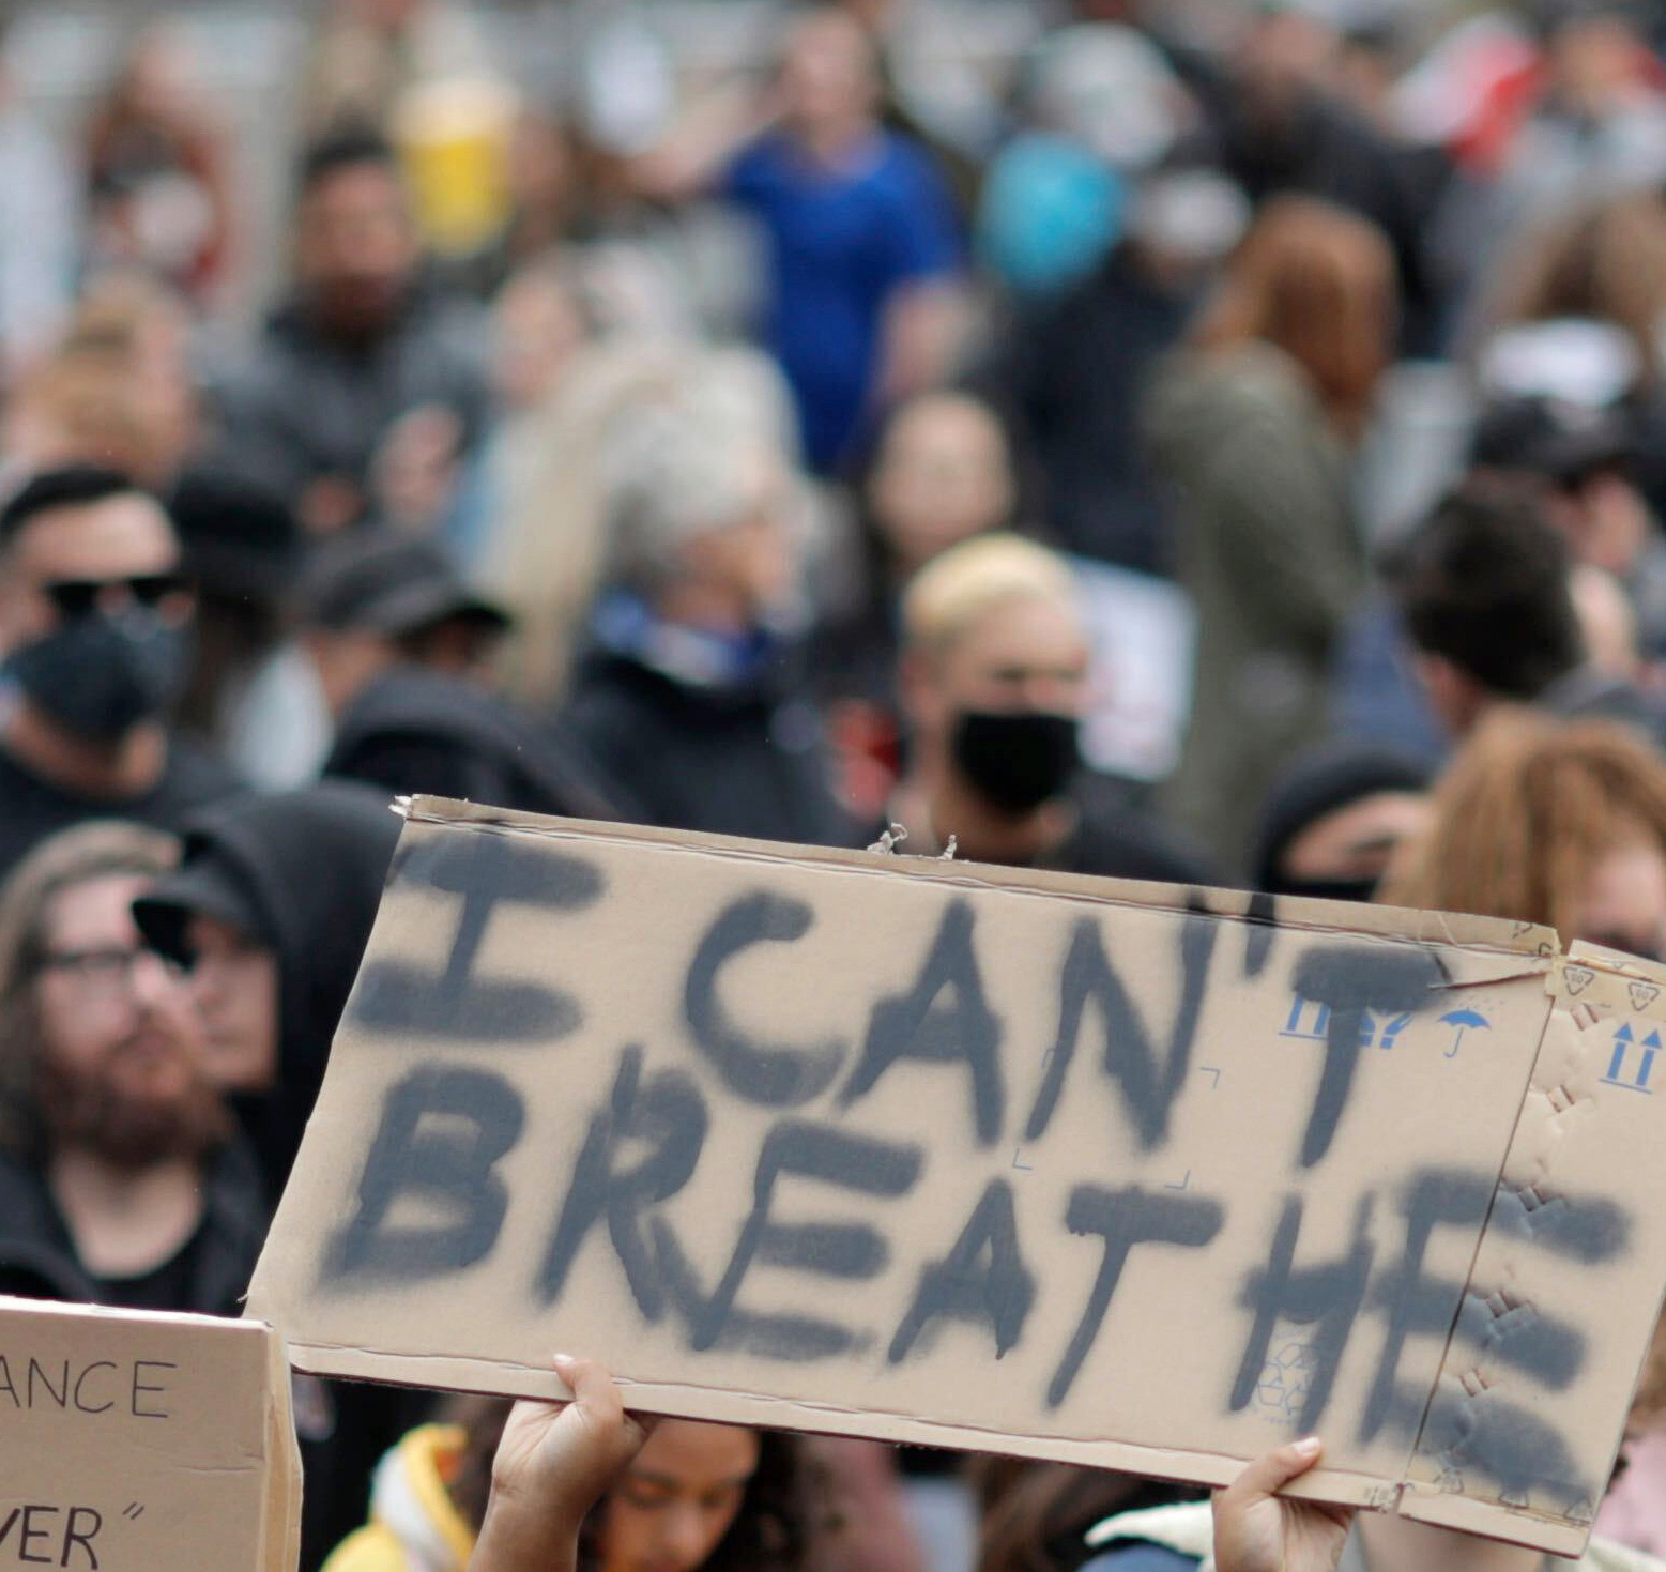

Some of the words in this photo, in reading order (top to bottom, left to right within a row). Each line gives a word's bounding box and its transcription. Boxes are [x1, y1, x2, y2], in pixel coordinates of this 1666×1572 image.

[341, 832, 605, 1044] I
[681, 885, 1449, 1170] CAN'T
[323, 1042, 1633, 1508] BREATHE
